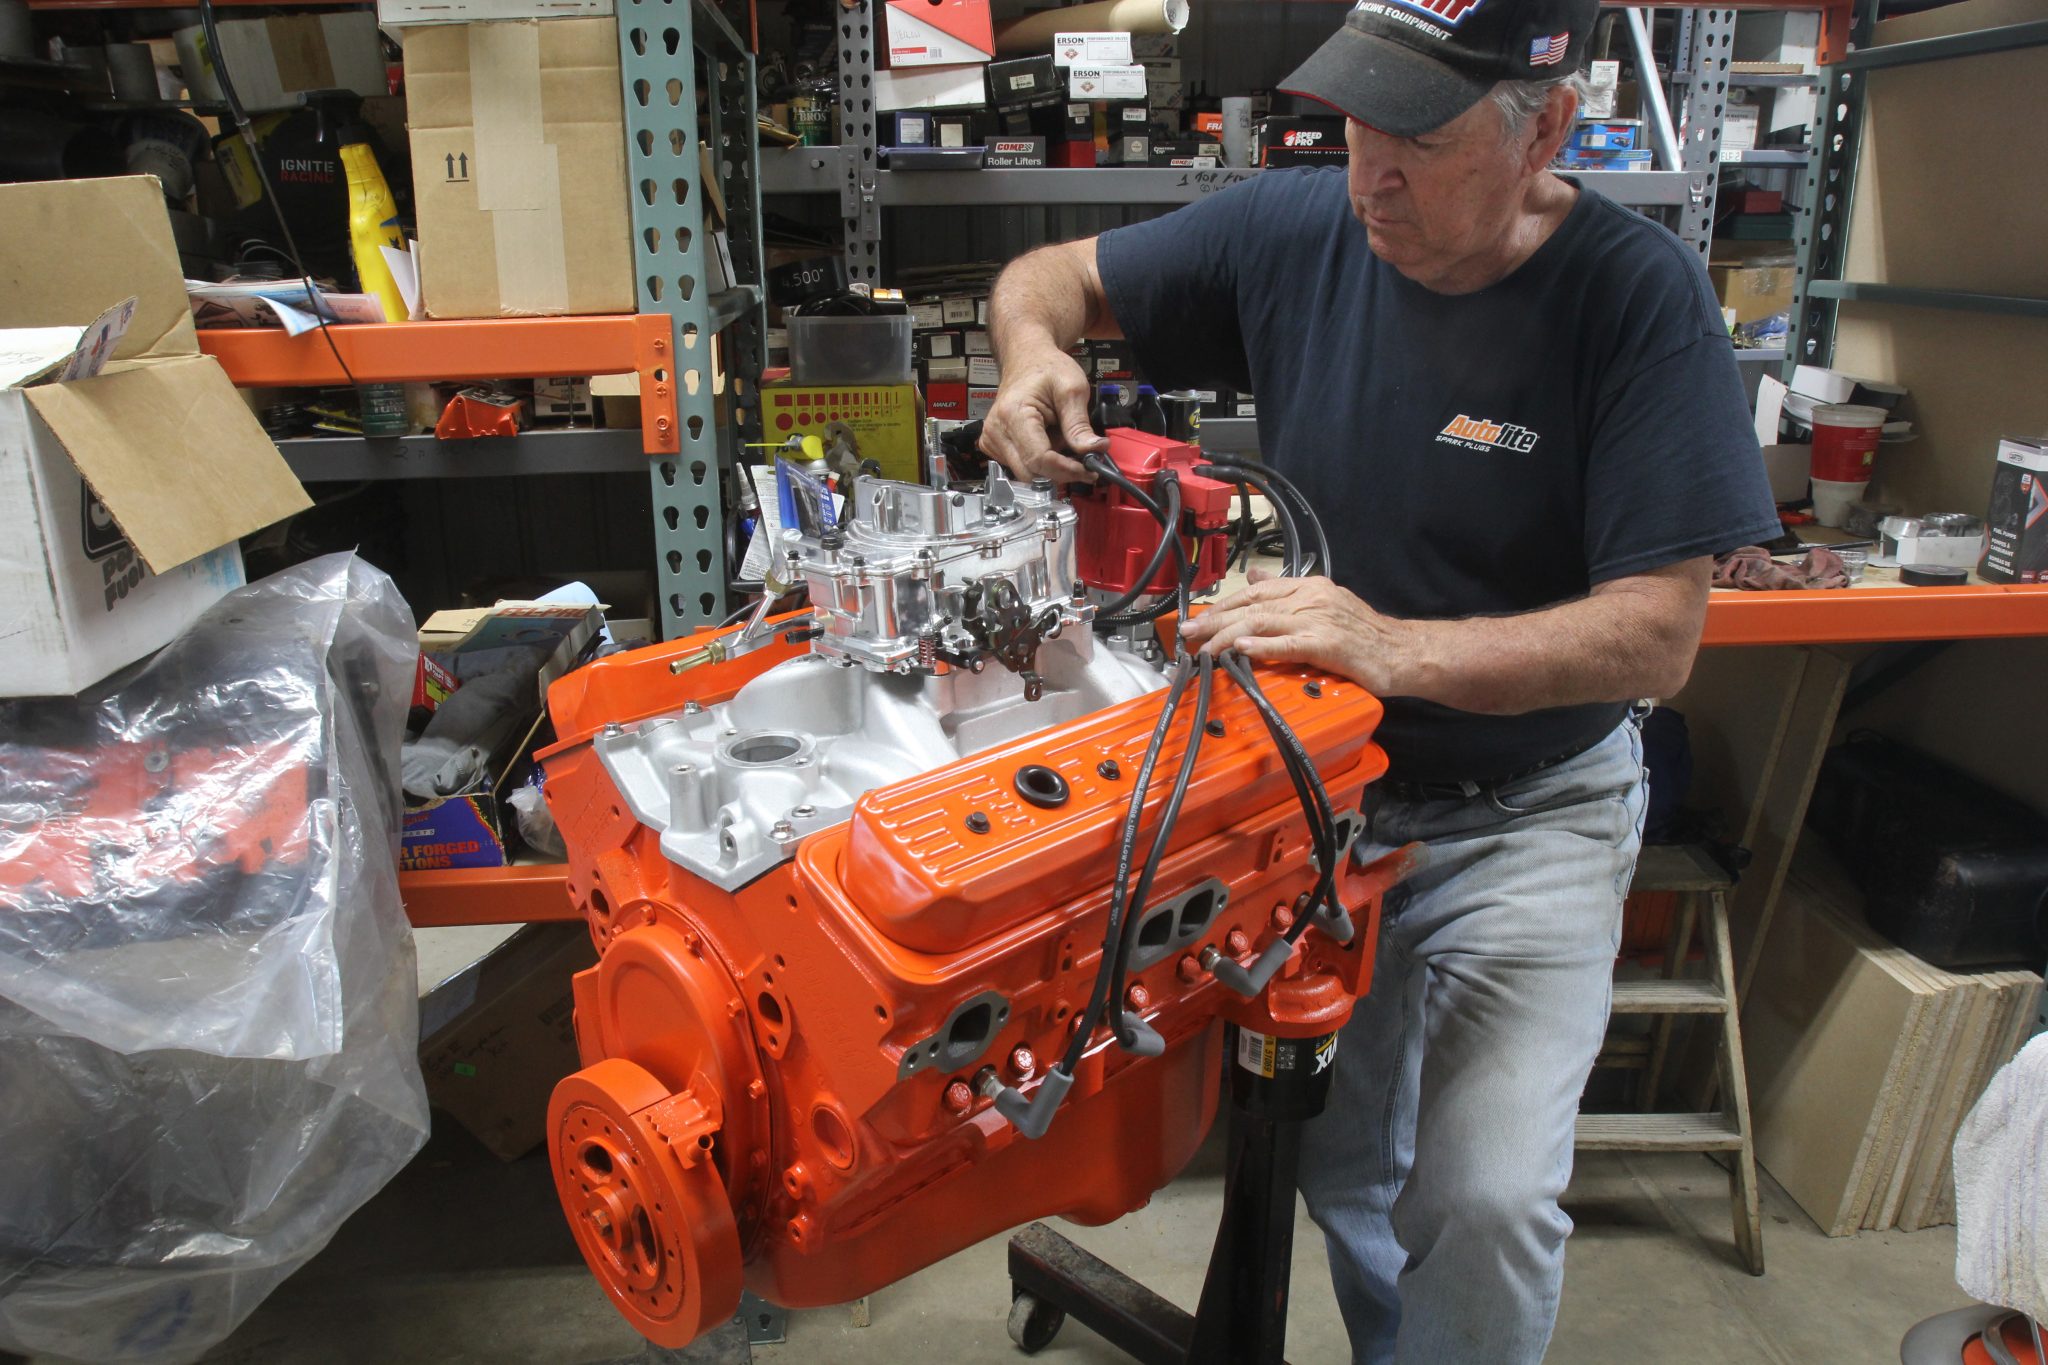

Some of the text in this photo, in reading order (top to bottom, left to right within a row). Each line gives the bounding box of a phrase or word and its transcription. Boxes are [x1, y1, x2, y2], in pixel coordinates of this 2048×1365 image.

[1385, 6, 1453, 41] EQUIPMENT
[799, 112, 826, 121] BROS
[1206, 122, 1223, 131] FRA
[1296, 131, 1323, 140] SPEED
[997, 143, 1024, 151] COMP
[987, 156, 1042, 166] Roller Lifters
[1720, 151, 1734, 161] ELF
[281, 159, 335, 172] IGNITE
[280, 171, 335, 183] RACING
[1440, 414, 1538, 453] Autolite
[1435, 435, 1492, 453] SPARK PLUGS
[1124, 824, 1136, 847] Ultra
[413, 840, 480, 859] FORGED
[1120, 844, 1131, 863] Low
[400, 855, 453, 869] STONS
[1118, 862, 1128, 882] Ohm
